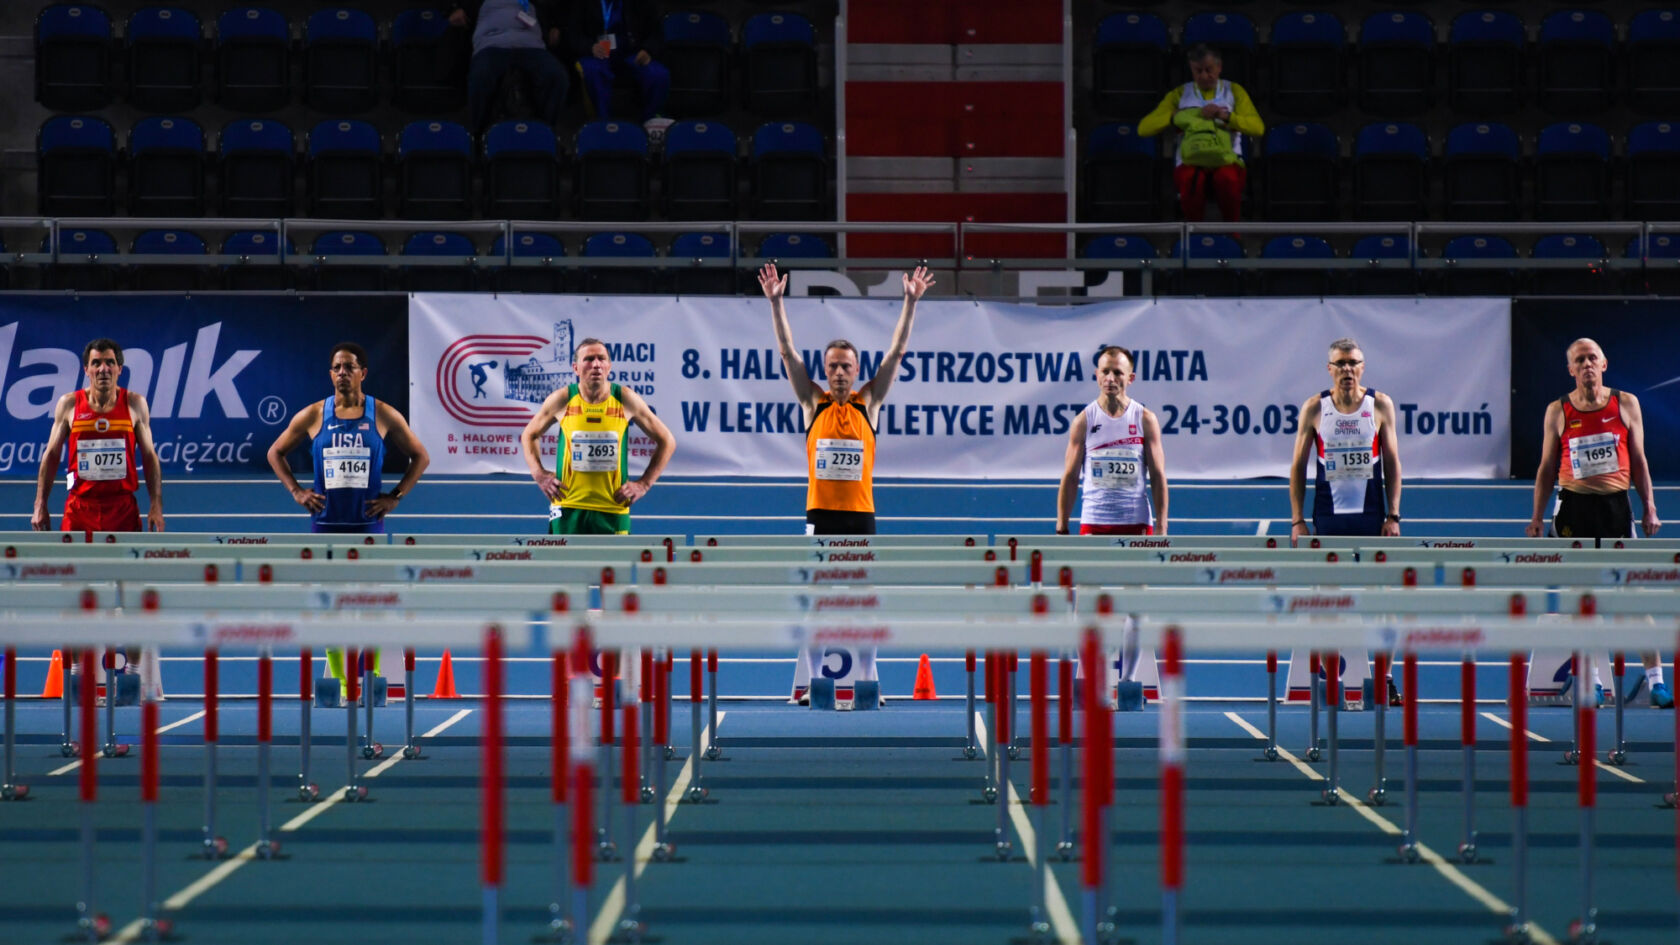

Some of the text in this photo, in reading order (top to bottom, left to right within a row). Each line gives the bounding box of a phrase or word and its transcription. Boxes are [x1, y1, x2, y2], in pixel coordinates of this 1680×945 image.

[682, 349, 711, 379] 8.
[720, 349, 827, 382] HALW
[858, 350, 1084, 383] MSTRZOSTWA
[607, 369, 654, 382] ORUŃ
[682, 402, 711, 432] W
[720, 402, 806, 434] LEKKI
[877, 405, 994, 436] TLETYCE
[1003, 403, 1087, 436] MAST
[1400, 403, 1492, 435] Toruń
[331, 432, 364, 449] USA
[447, 433, 458, 443] 8.
[463, 433, 513, 443] HALOWE
[447, 446, 518, 455] W LEKKIEJ
[588, 445, 615, 457] 2693
[1584, 447, 1613, 461] 1695
[94, 453, 123, 466] 0775
[832, 453, 861, 466] 2739
[1342, 453, 1370, 465] 1538
[339, 461, 367, 473] 4164
[1108, 462, 1136, 474] 3229
[144, 549, 191, 559] polanik
[486, 550, 532, 560] polanik
[829, 551, 875, 562] polanik
[1170, 552, 1216, 562] polanik
[1515, 552, 1562, 563] polanik
